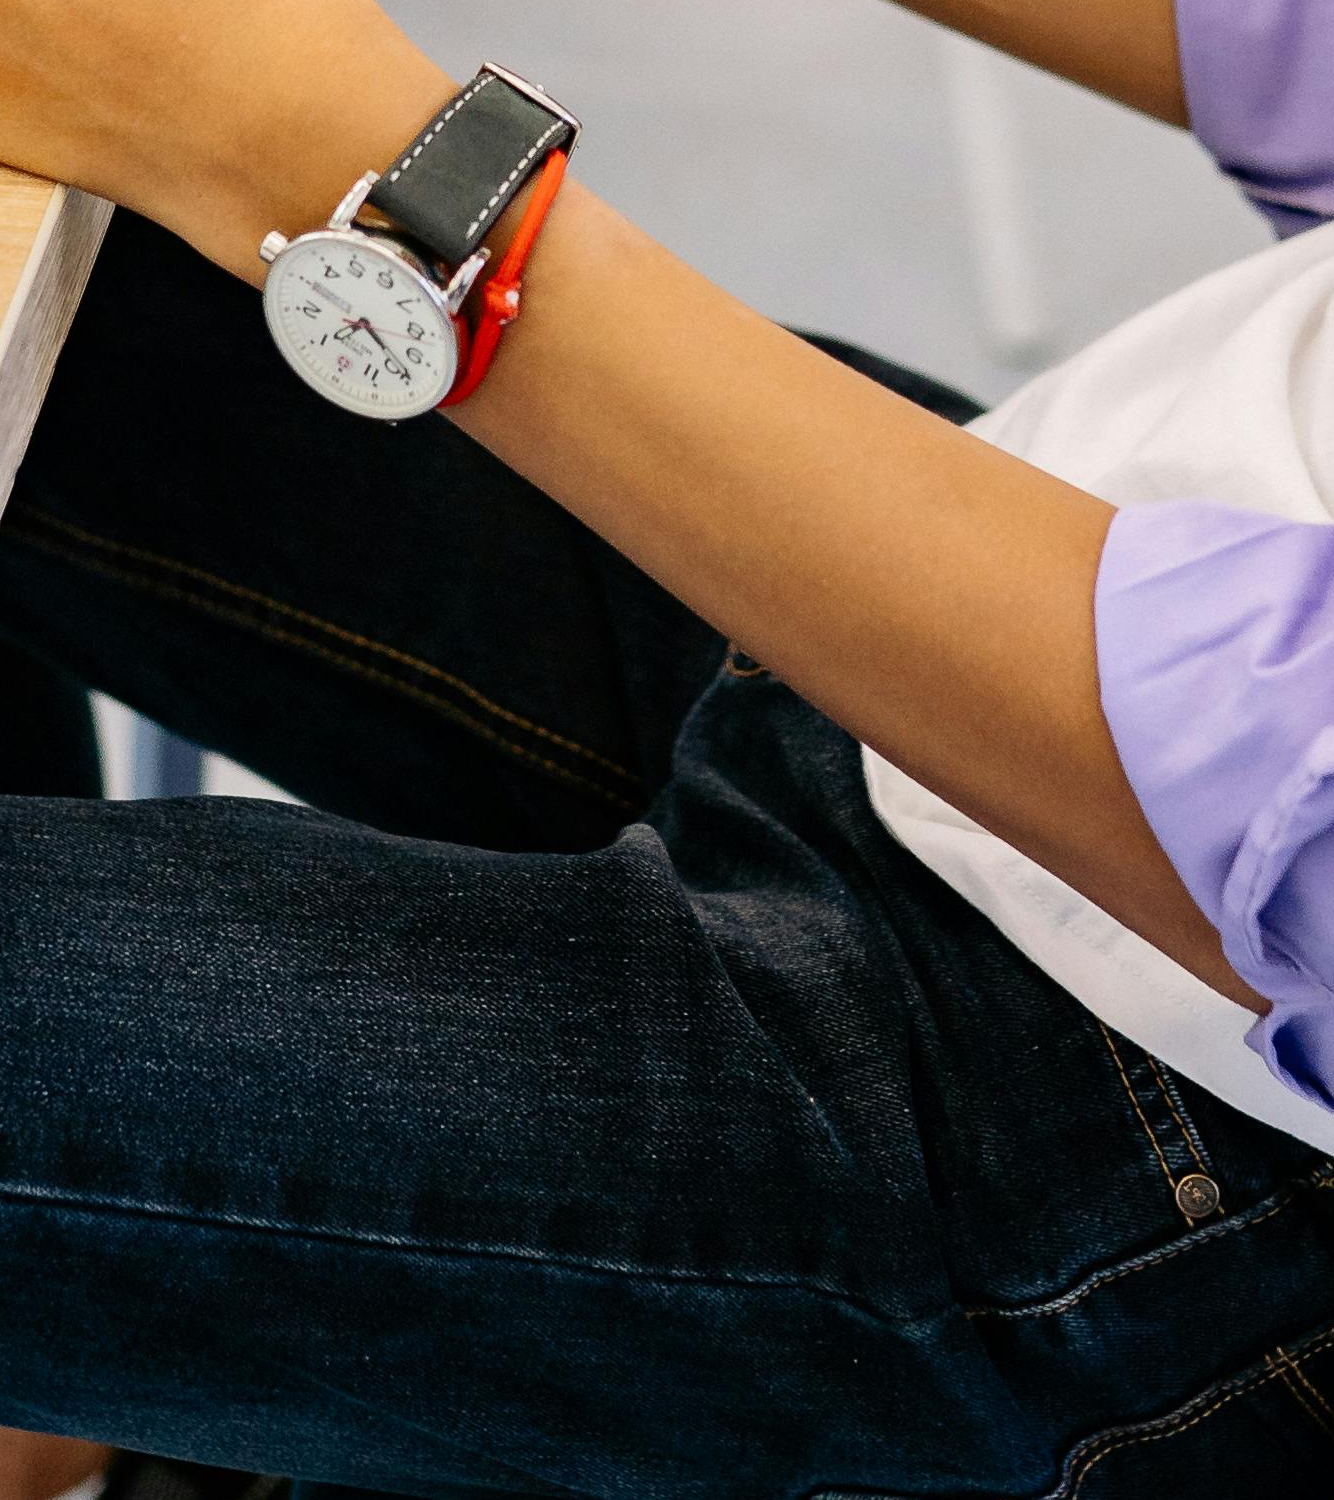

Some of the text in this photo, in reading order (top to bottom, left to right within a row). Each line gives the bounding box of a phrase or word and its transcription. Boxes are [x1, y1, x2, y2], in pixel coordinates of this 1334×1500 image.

[324, 265, 341, 279] 4
[348, 259, 366, 279] 5
[377, 271, 394, 289] 6
[302, 300, 322, 319] 2
[395, 298, 413, 314] 7
[406, 321, 425, 340] 8
[320, 334, 328, 346] 1
[406, 347, 423, 364] 9
[363, 364, 379, 381] 11
